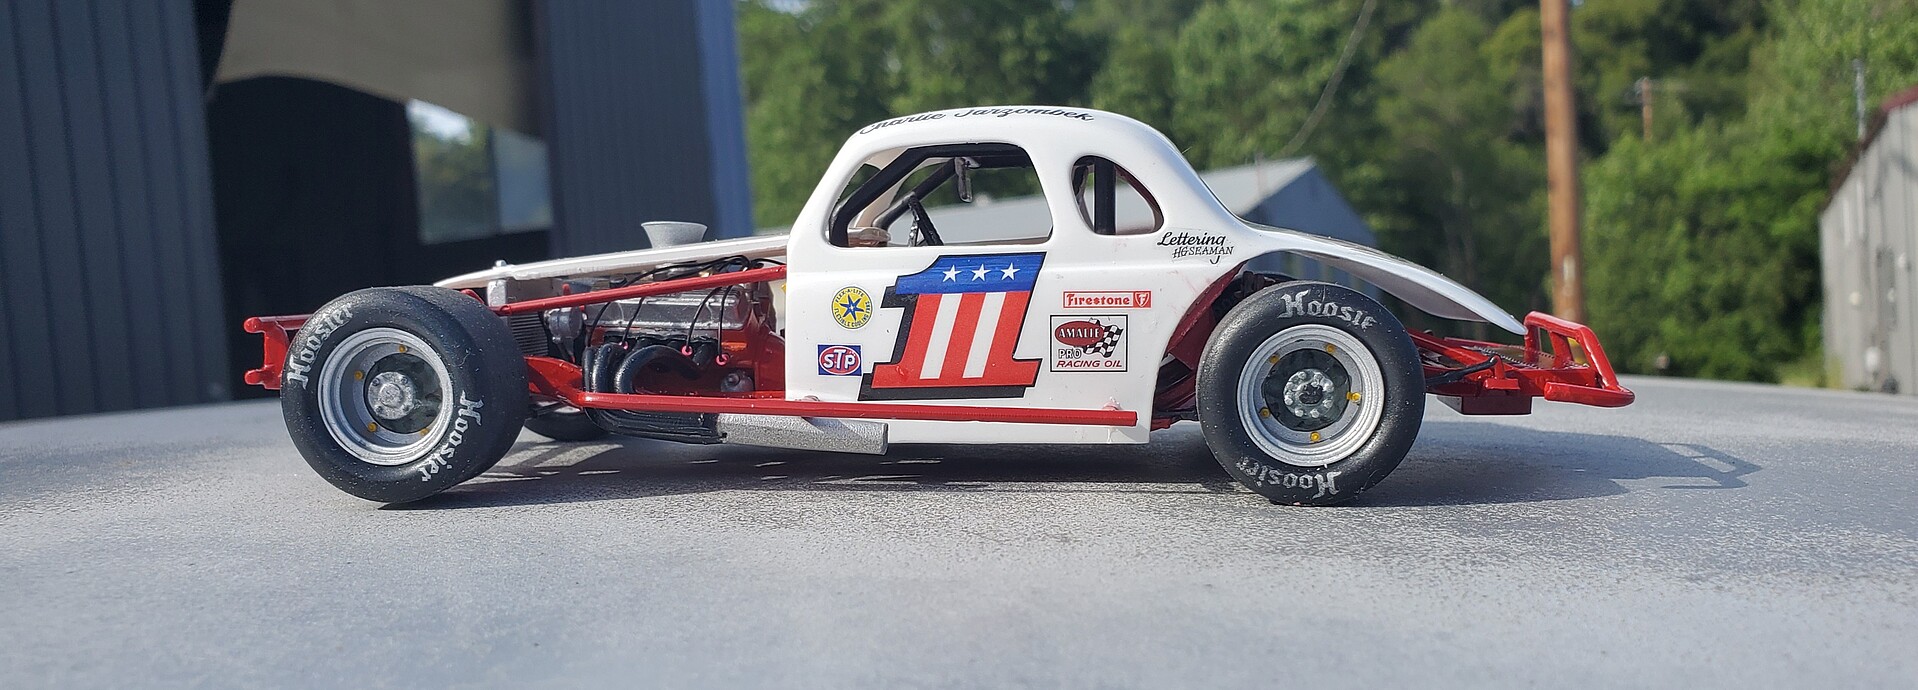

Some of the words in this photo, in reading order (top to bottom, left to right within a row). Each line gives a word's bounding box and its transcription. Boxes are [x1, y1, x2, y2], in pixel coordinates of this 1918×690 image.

[1157, 231, 1227, 265] Lettering
[1066, 294, 1130, 307] Firestone
[858, 252, 1047, 401] 1
[1058, 328, 1100, 338] AMALIE
[286, 302, 353, 390] Hoosier
[1058, 348, 1082, 359] PRO
[823, 349, 856, 370] STP
[1056, 360, 1101, 368] RACING
[1104, 360, 1123, 368] OIL
[420, 390, 485, 482] Hoosier
